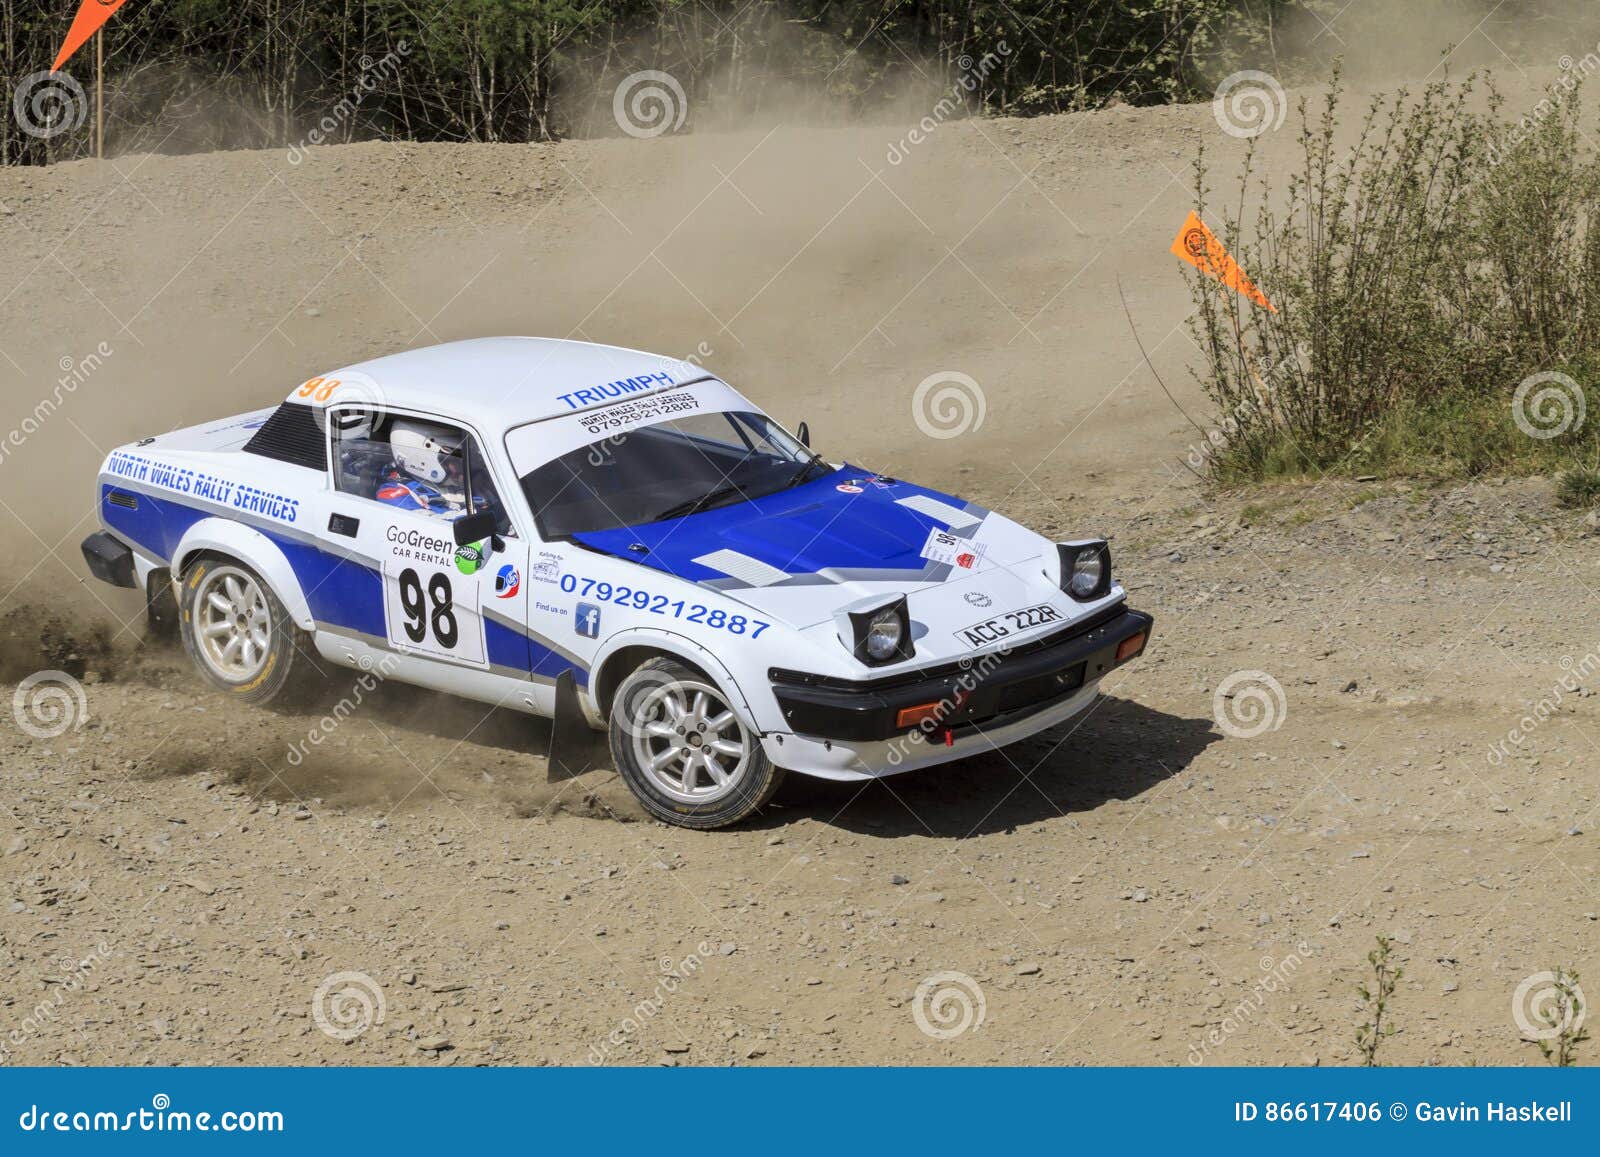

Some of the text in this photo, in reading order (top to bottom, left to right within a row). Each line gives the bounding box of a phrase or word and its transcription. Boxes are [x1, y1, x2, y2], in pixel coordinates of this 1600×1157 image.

[298, 376, 341, 401] 98
[556, 371, 677, 409] TRIUMPH
[587, 400, 702, 434] 07929212887
[107, 451, 300, 523] NORTH WALES RALLY SERVICES
[386, 525, 453, 555] GoGreen
[392, 546, 452, 567] CAR RENTAL
[934, 533, 957, 546] 98
[398, 567, 459, 649] 98
[536, 602, 550, 611] Find
[560, 574, 771, 640] 07929212887
[963, 605, 1067, 648] ACG 222R
